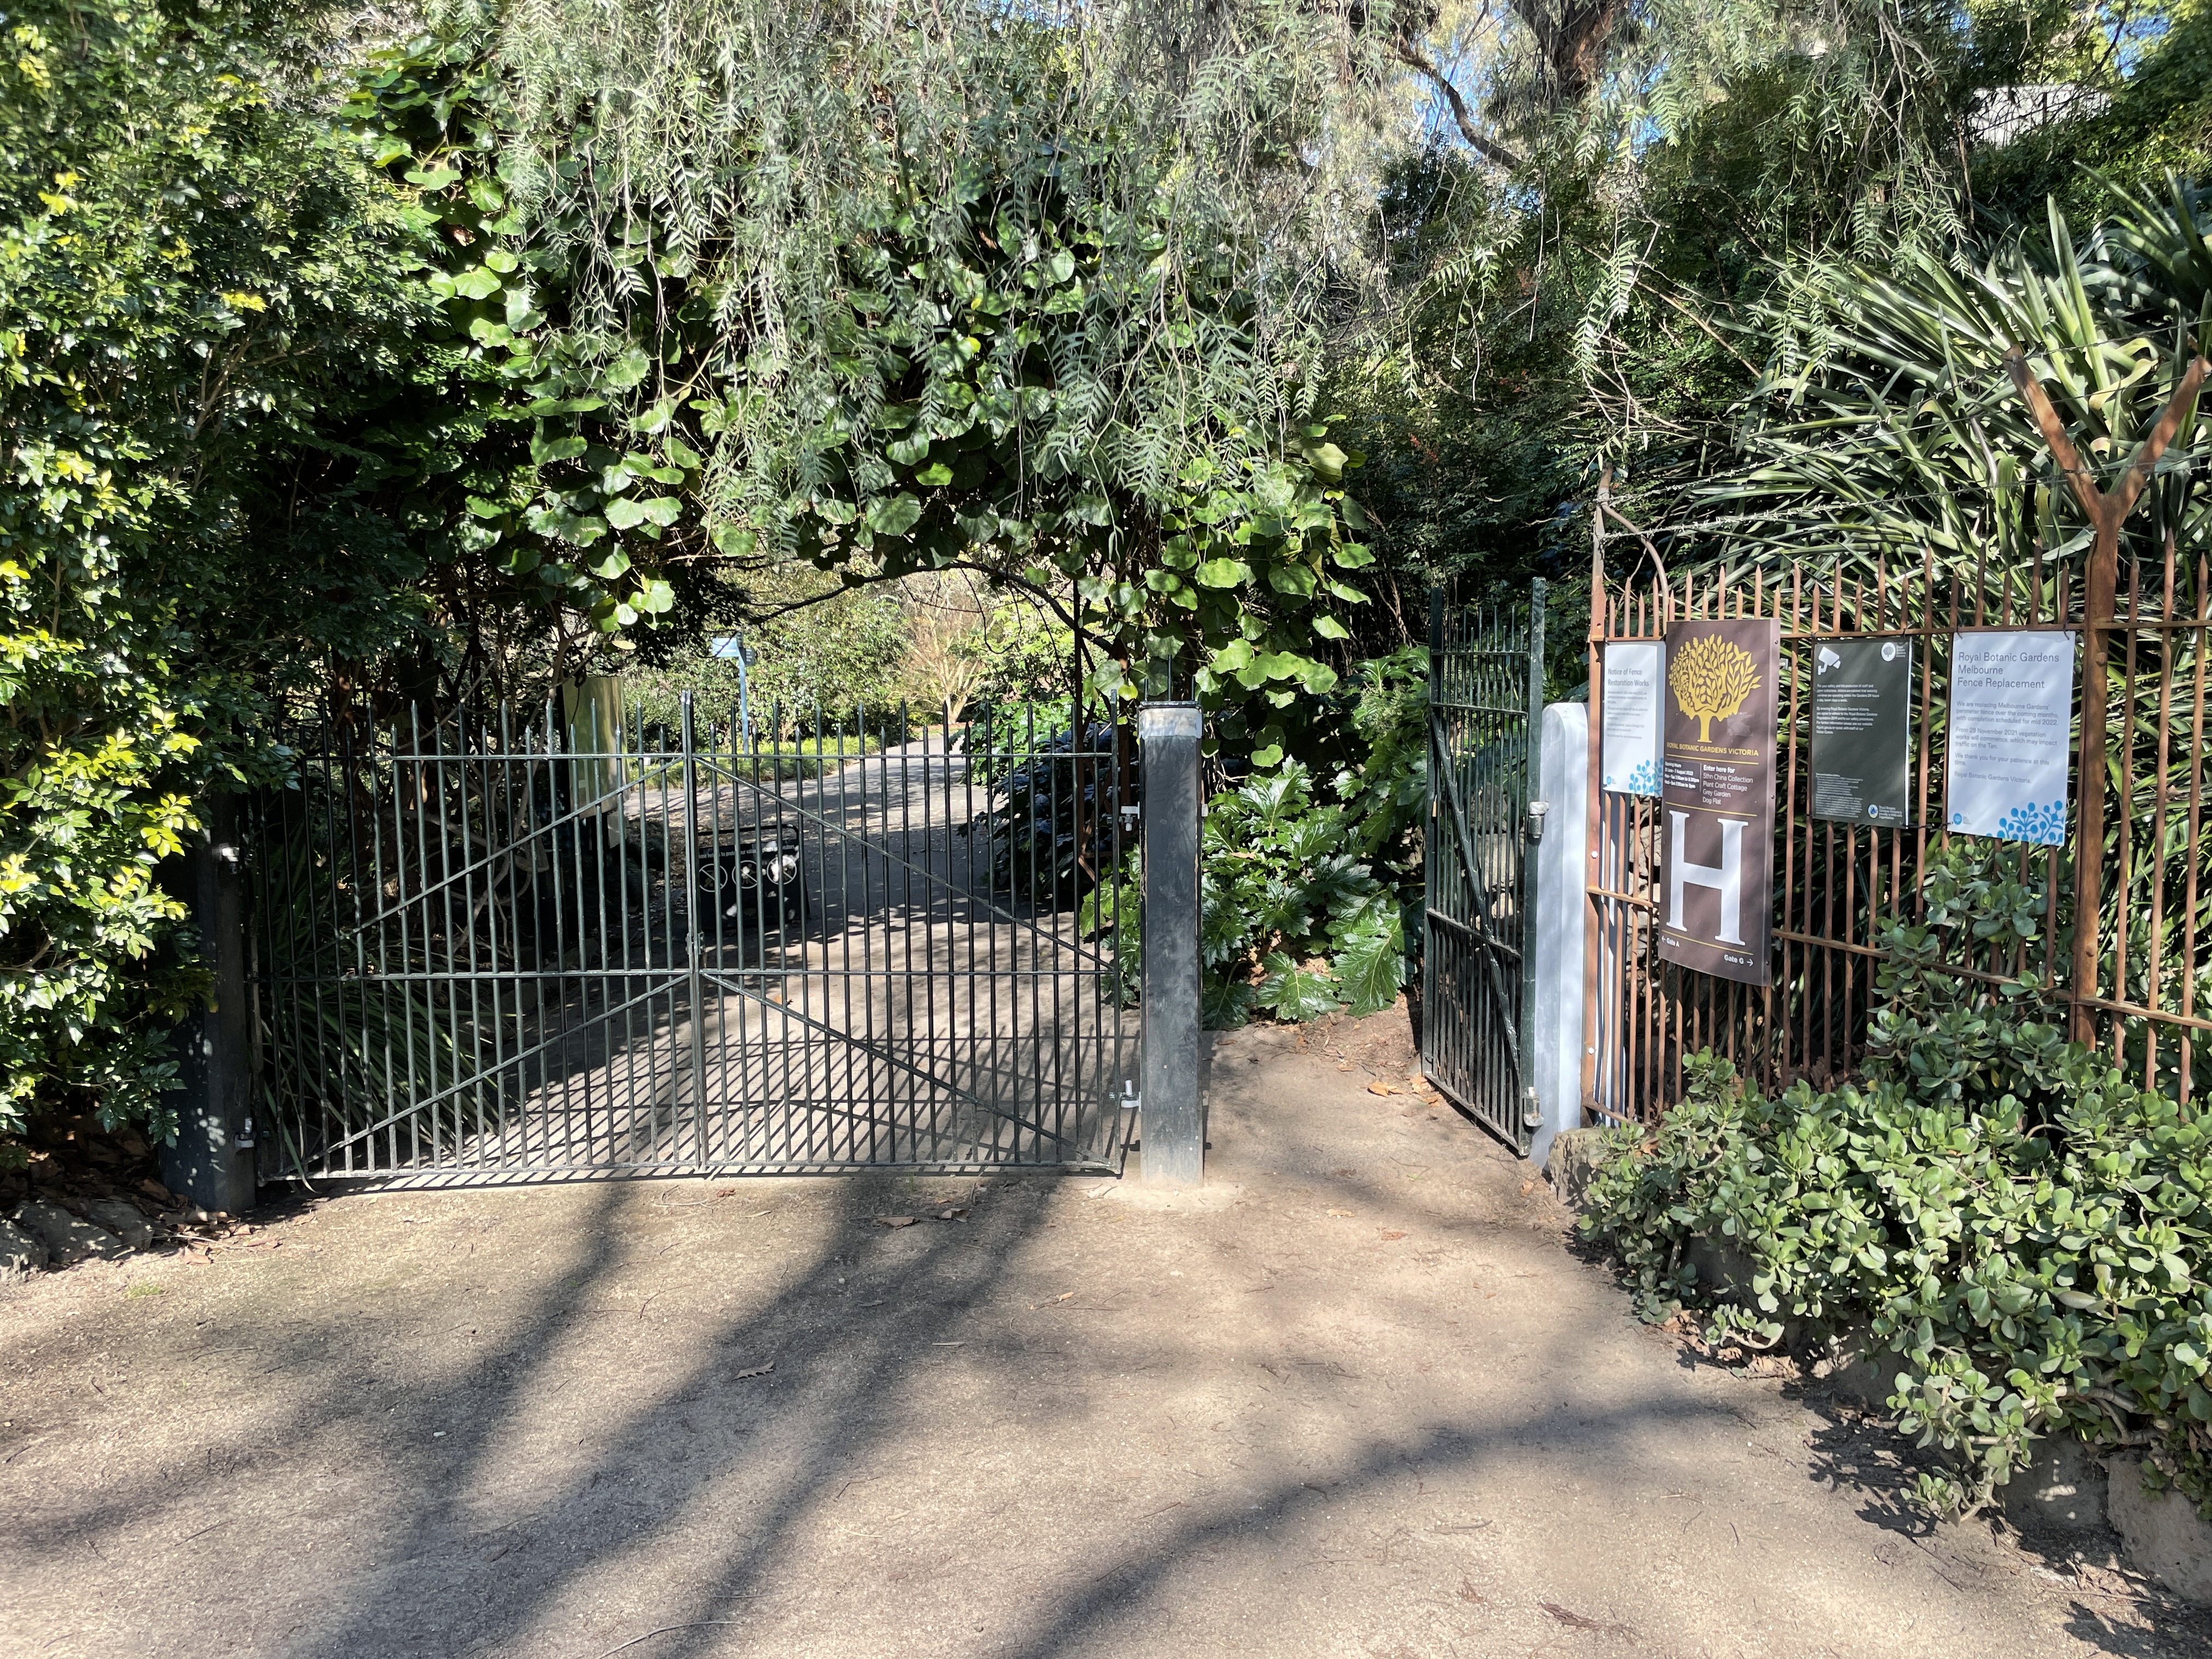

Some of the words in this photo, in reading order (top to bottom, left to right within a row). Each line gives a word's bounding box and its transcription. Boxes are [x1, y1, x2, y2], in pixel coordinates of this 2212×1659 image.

[1959, 652, 1981, 663] Royal
[1984, 652, 2017, 662] Botanic
[2020, 652, 2059, 662] Gardens
[1958, 664, 2003, 674] Melbourne
[1957, 677, 1983, 687] Fence
[1986, 678, 2045, 690] Replacement
[1679, 743, 1699, 752] BOTANIC
[1700, 746, 1727, 754] GARDENS
[1728, 748, 1759, 757] VICTORIA
[1728, 775, 1753, 783] Collection
[1727, 783, 1748, 792] Cottage
[1702, 788, 1713, 797] Grey
[1702, 797, 1712, 805] Dog
[1666, 810, 1748, 946] H
[1666, 937, 1675, 946] Gate
[1724, 954, 1738, 963] Gate
